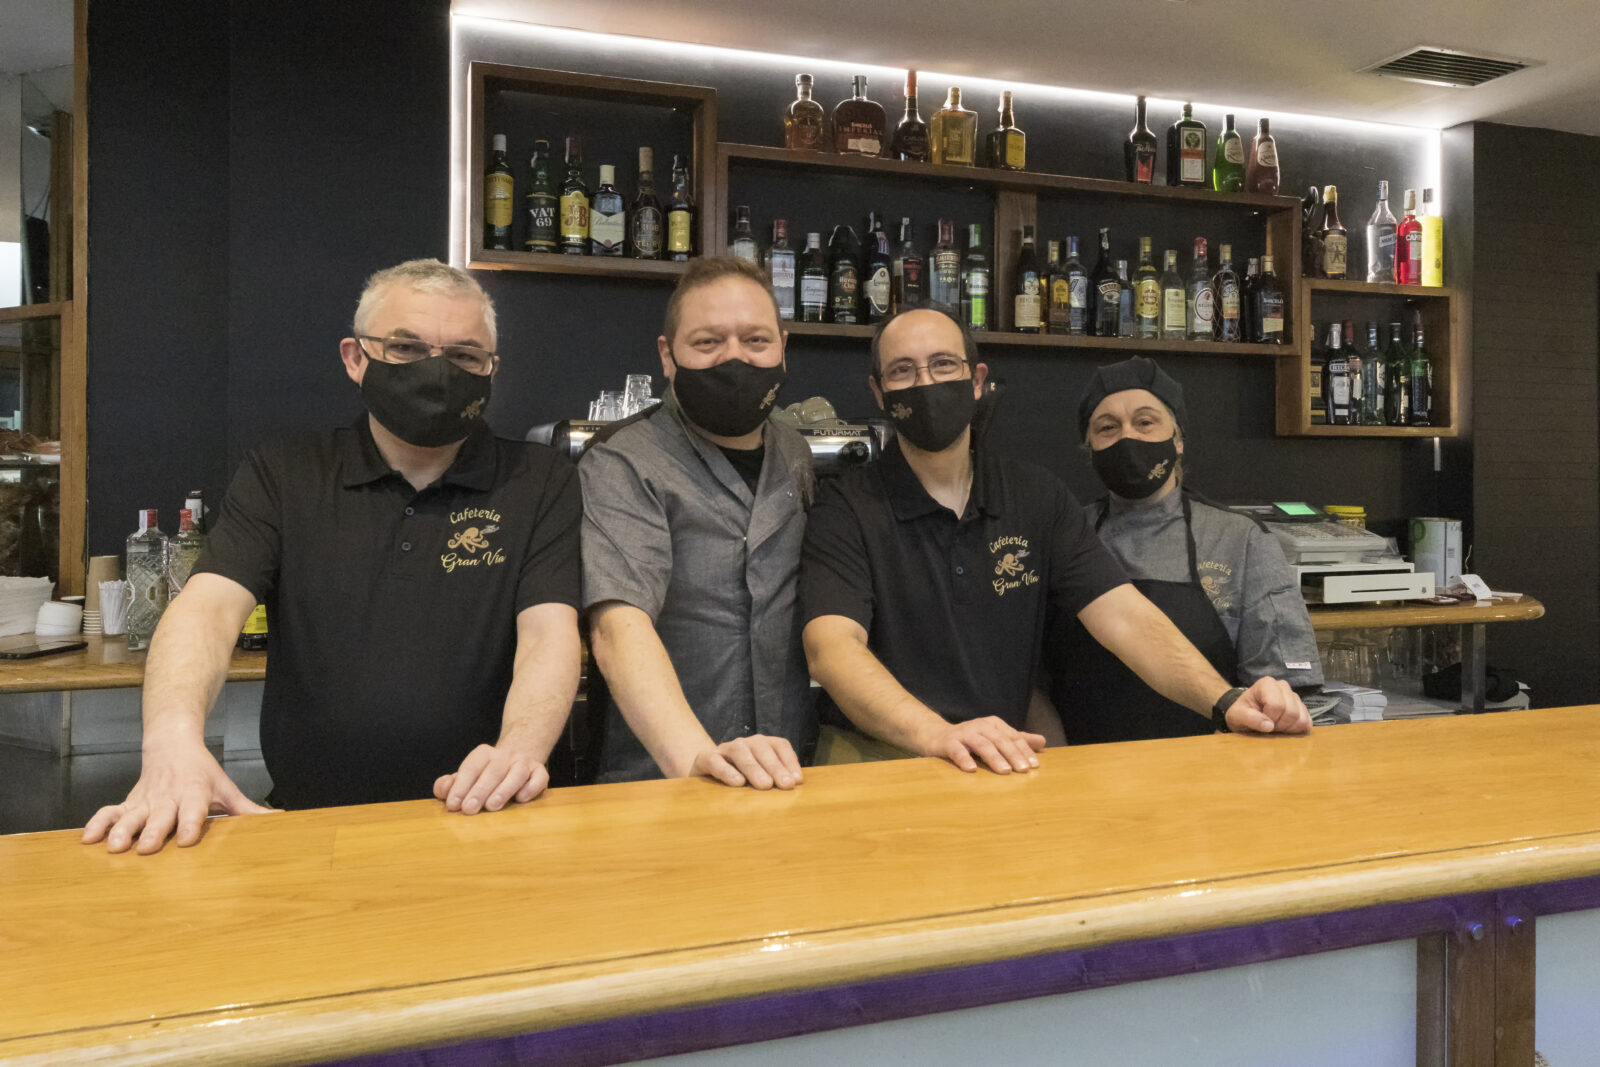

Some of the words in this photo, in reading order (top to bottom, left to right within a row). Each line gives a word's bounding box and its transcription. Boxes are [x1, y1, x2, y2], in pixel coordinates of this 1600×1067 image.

[530, 207, 556, 218] VAT
[535, 218, 552, 227] 69
[440, 552, 480, 573] Gran
[992, 577, 1021, 597] Gran
